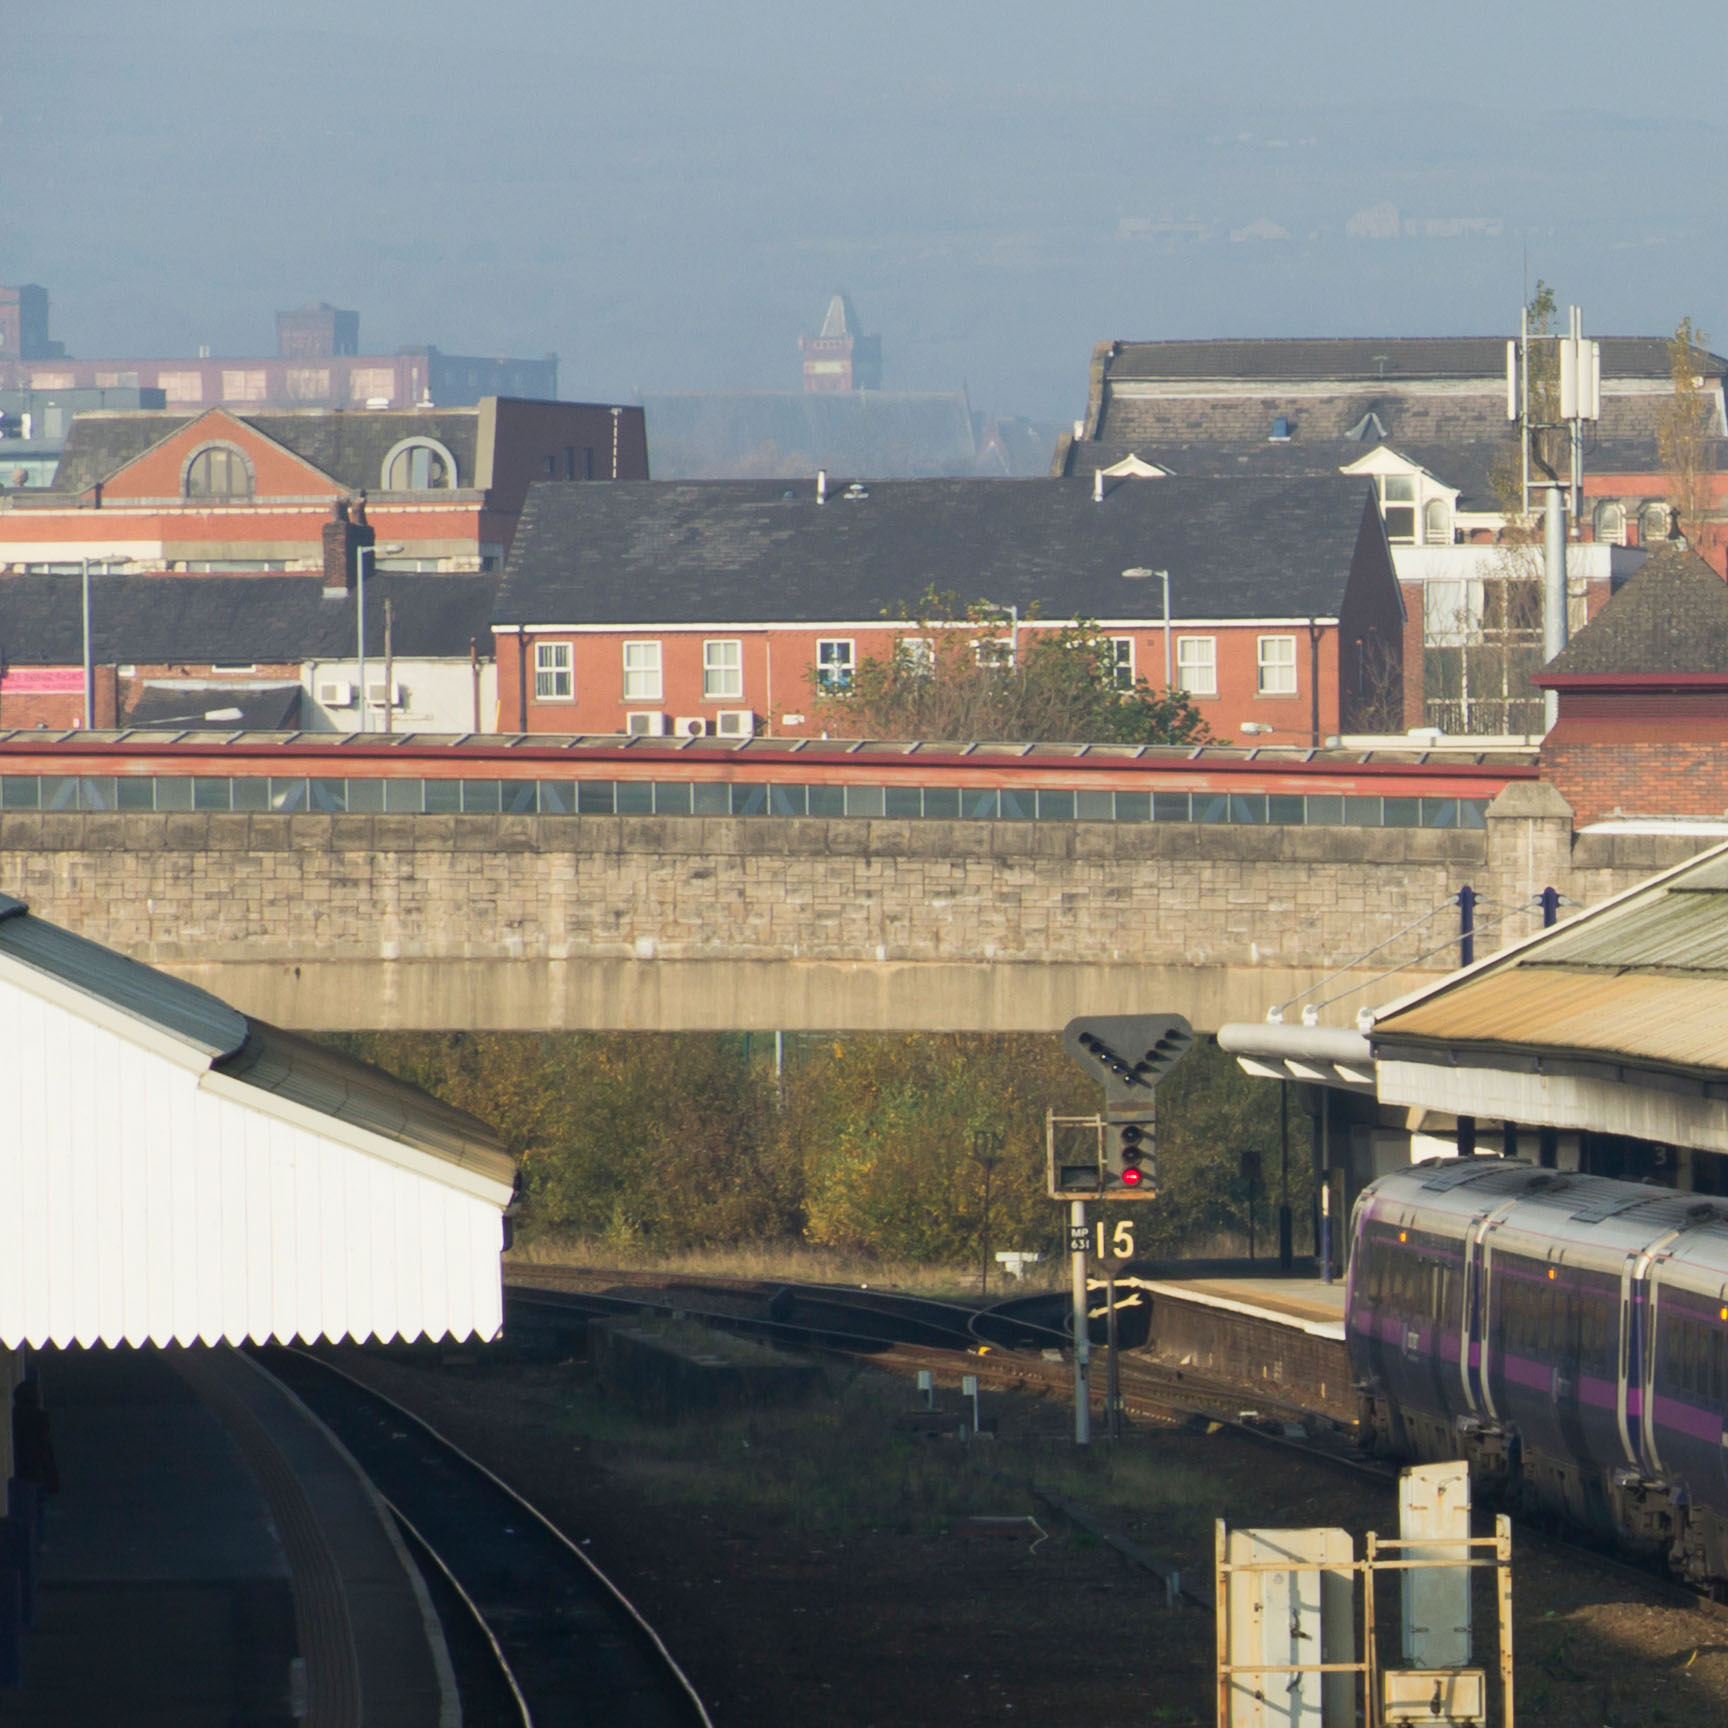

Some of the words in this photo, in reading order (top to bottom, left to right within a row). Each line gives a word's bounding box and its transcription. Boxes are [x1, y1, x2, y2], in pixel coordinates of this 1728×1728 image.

[1071, 1228, 1089, 1238] MP
[1071, 1239, 1090, 1250] 631
[1096, 1220, 1135, 1259] 15
